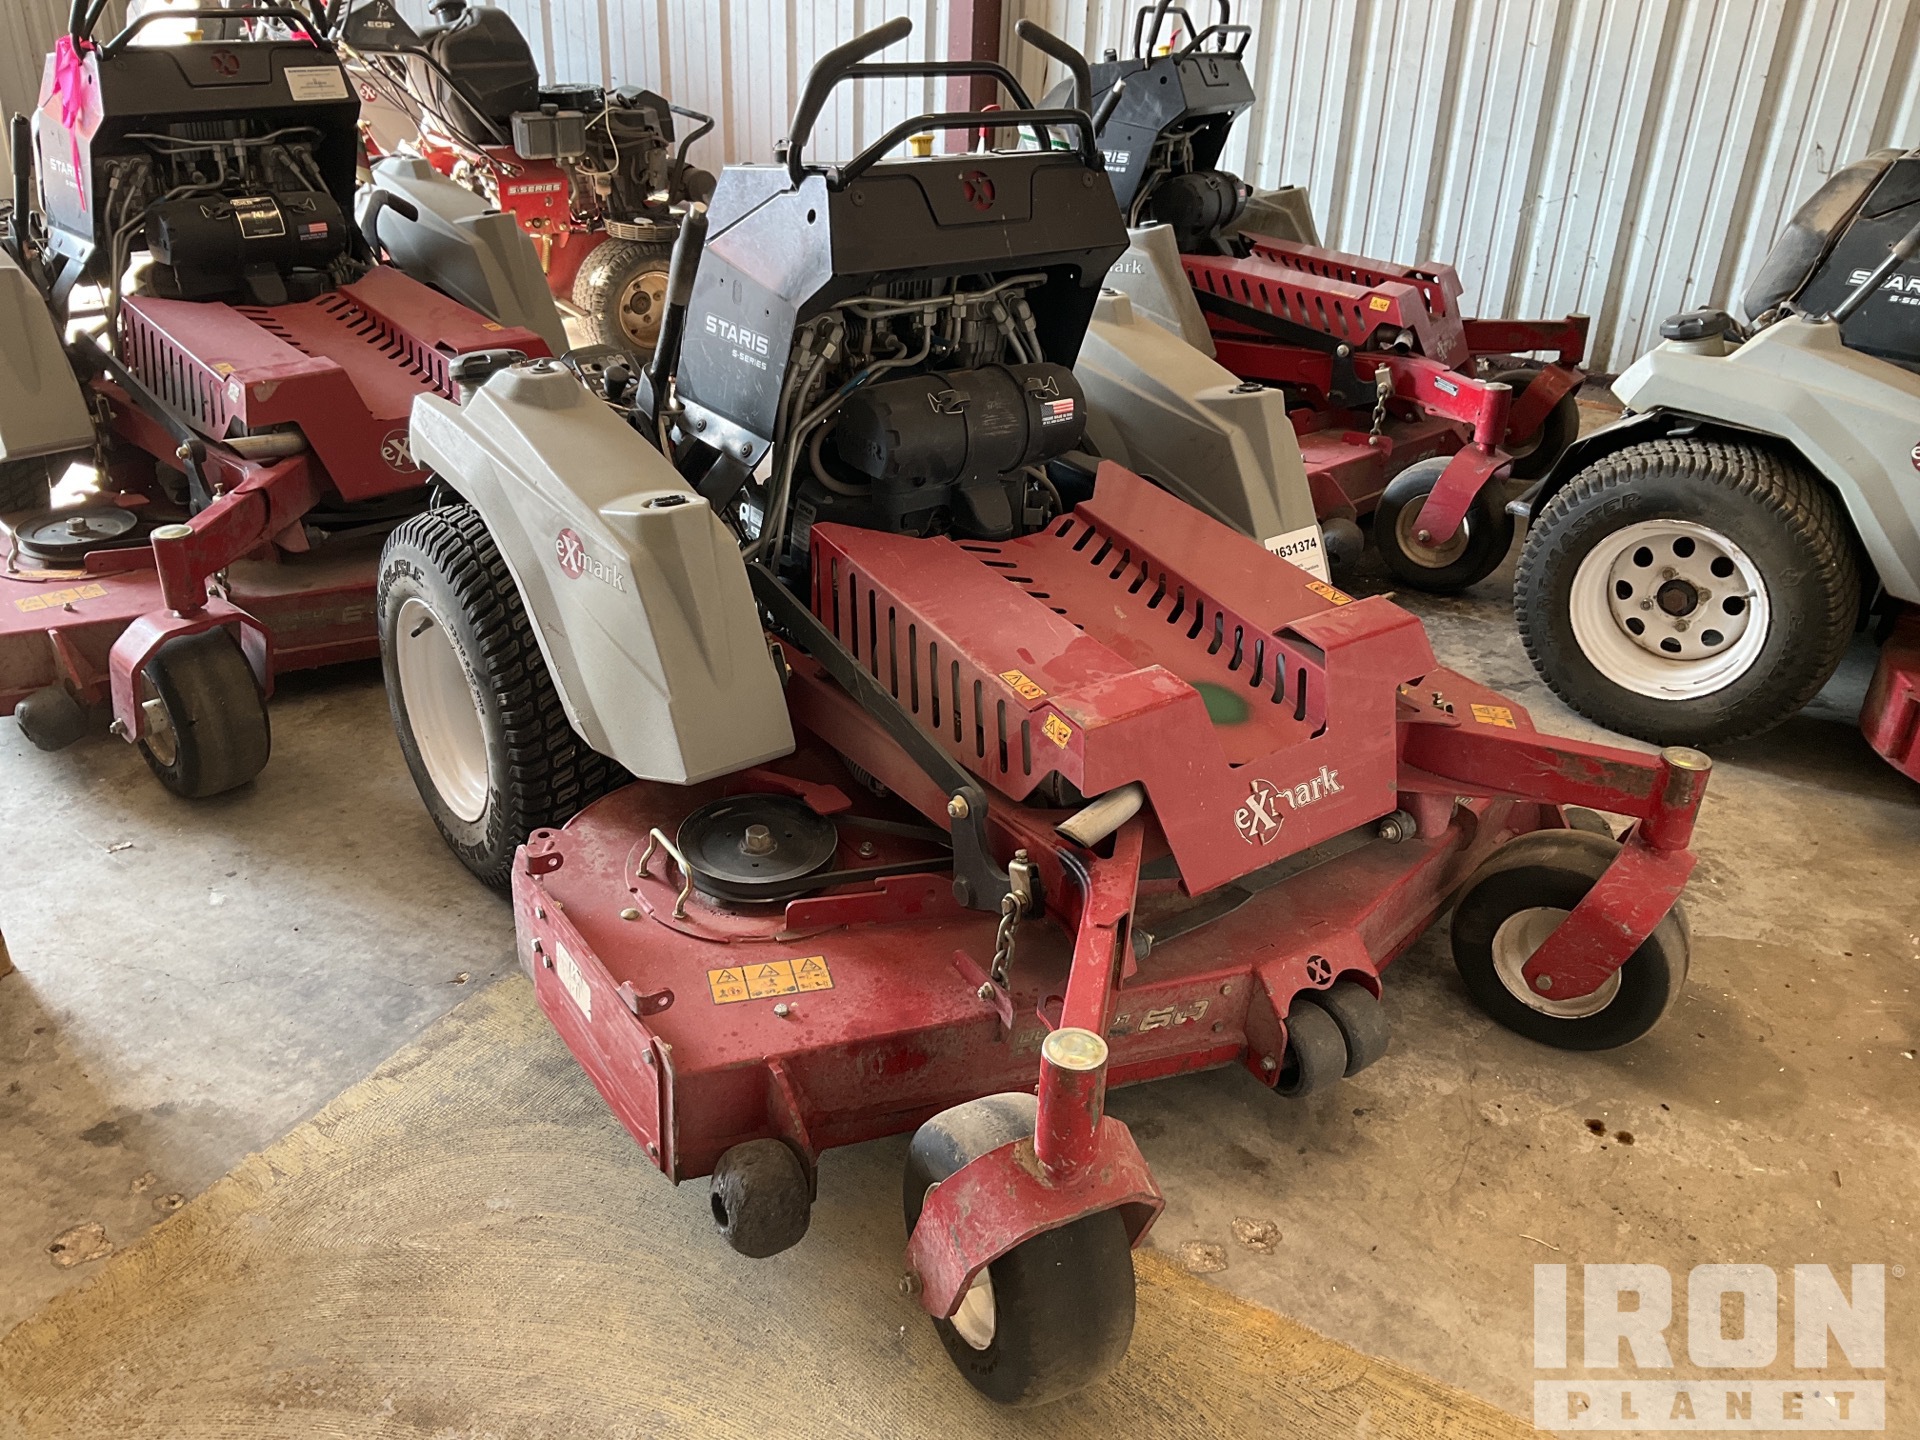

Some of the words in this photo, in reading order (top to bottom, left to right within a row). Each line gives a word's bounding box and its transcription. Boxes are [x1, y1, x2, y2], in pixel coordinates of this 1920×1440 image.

[1110, 260, 1142, 275] ark
[705, 314, 769, 356] STARIS
[555, 531, 627, 593] eXmark
